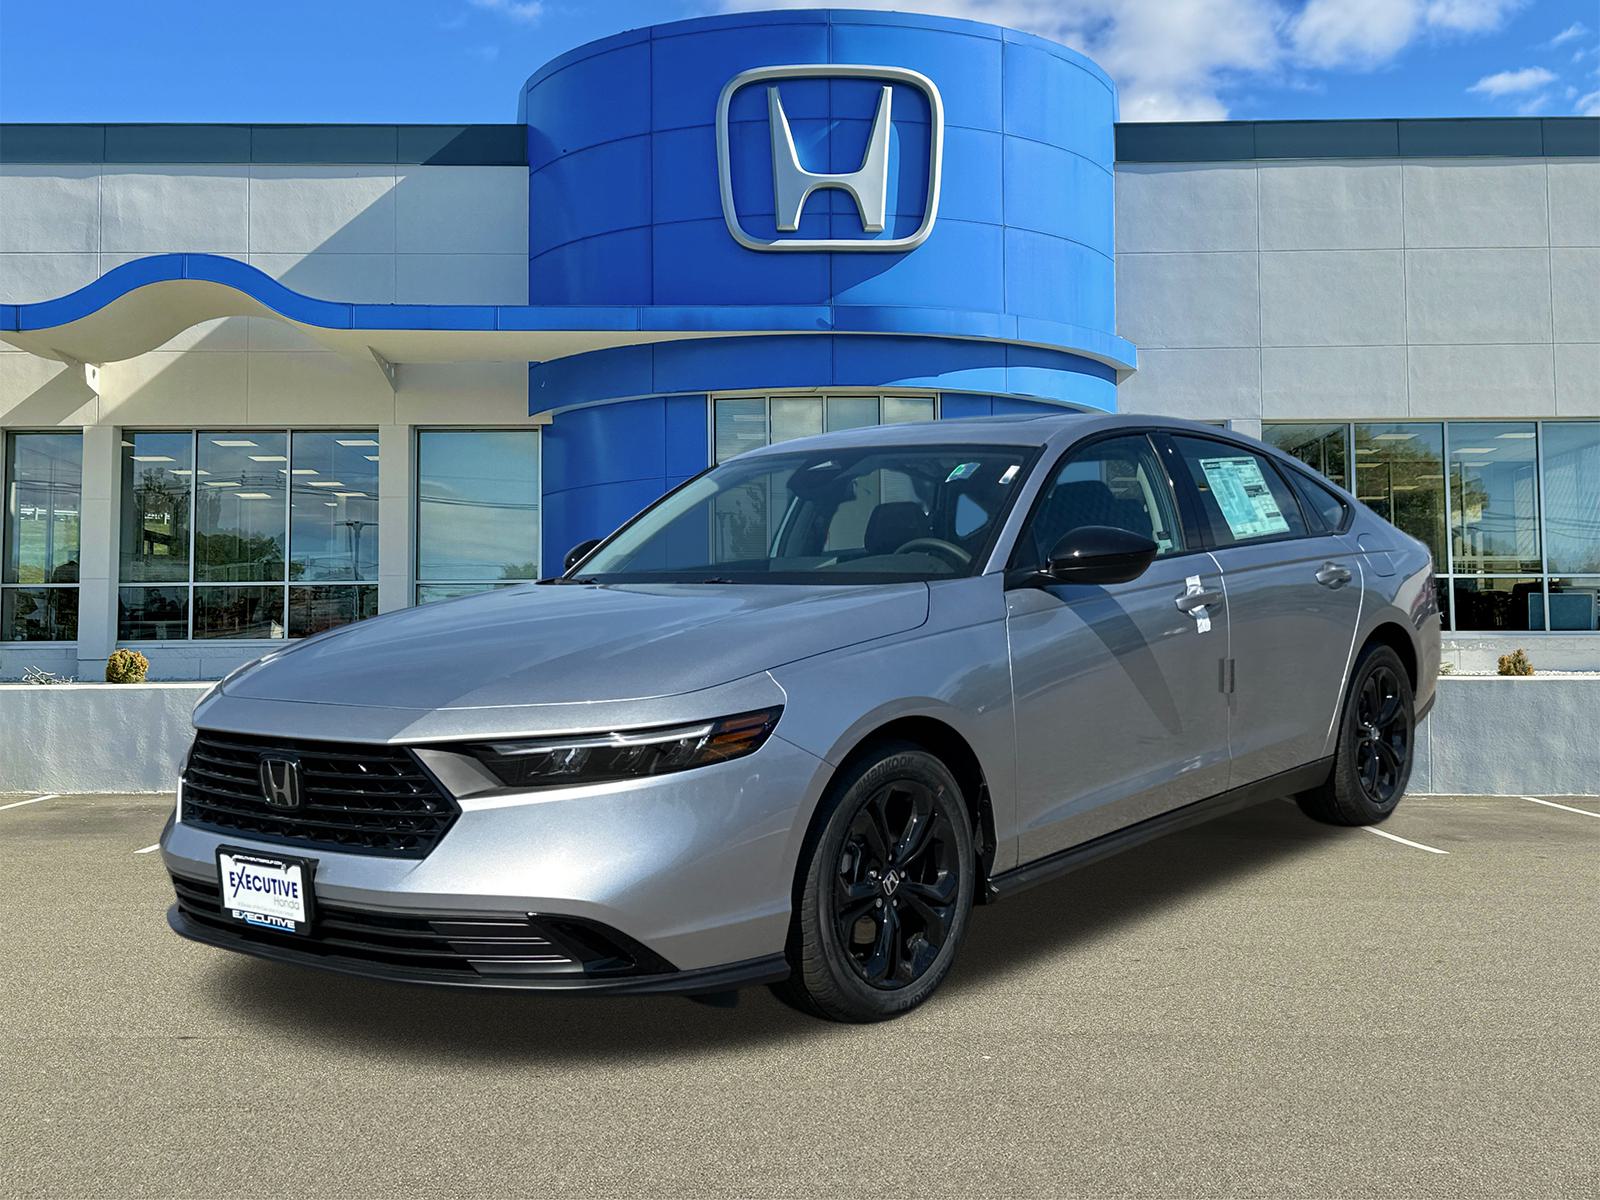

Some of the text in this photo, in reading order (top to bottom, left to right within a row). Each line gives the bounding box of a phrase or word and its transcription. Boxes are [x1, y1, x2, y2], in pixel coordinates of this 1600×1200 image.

[229, 866, 298, 899] EXECUTIVE
[273, 896, 300, 910] Honda
[232, 909, 296, 929] EXECUTIVE
